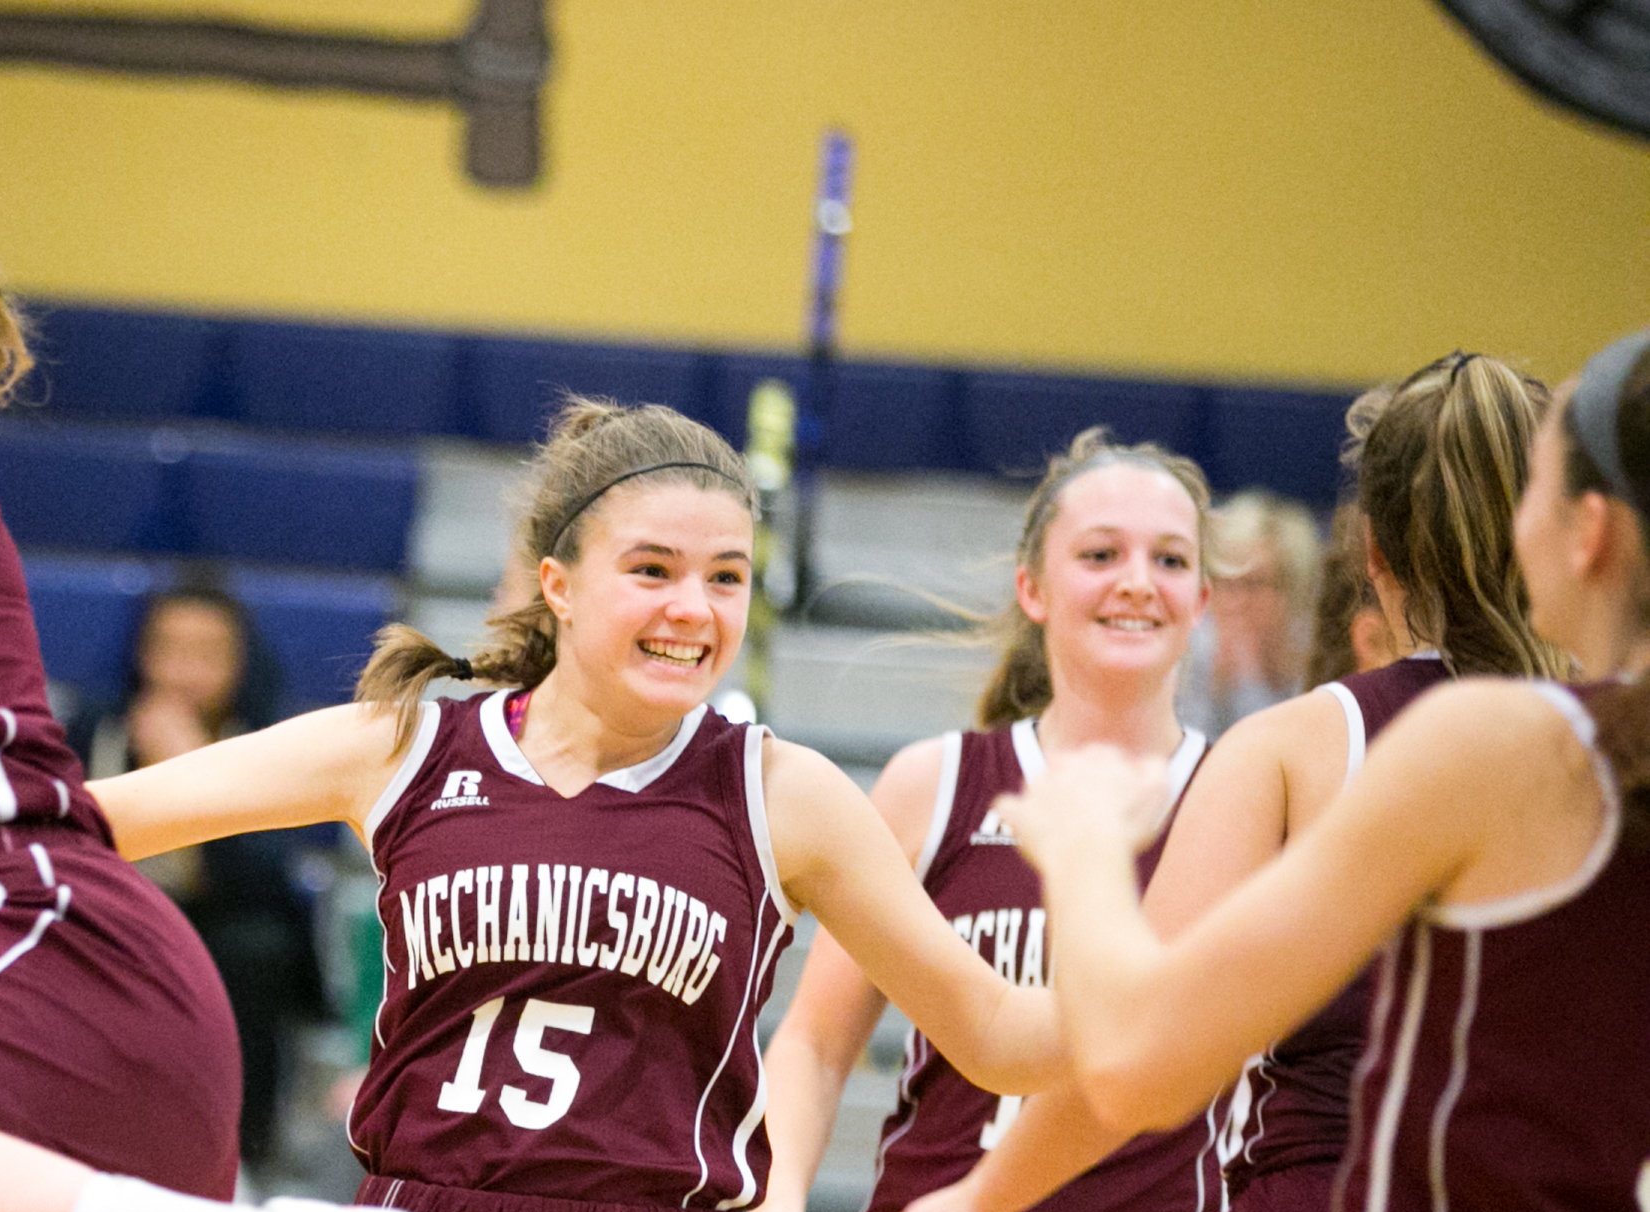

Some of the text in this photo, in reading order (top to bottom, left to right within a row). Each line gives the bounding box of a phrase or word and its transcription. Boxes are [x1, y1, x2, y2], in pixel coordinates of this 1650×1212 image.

[430, 796, 490, 811] RUSSELL
[399, 863, 728, 1006] MECHANICSBURG
[437, 996, 596, 1130] 15
